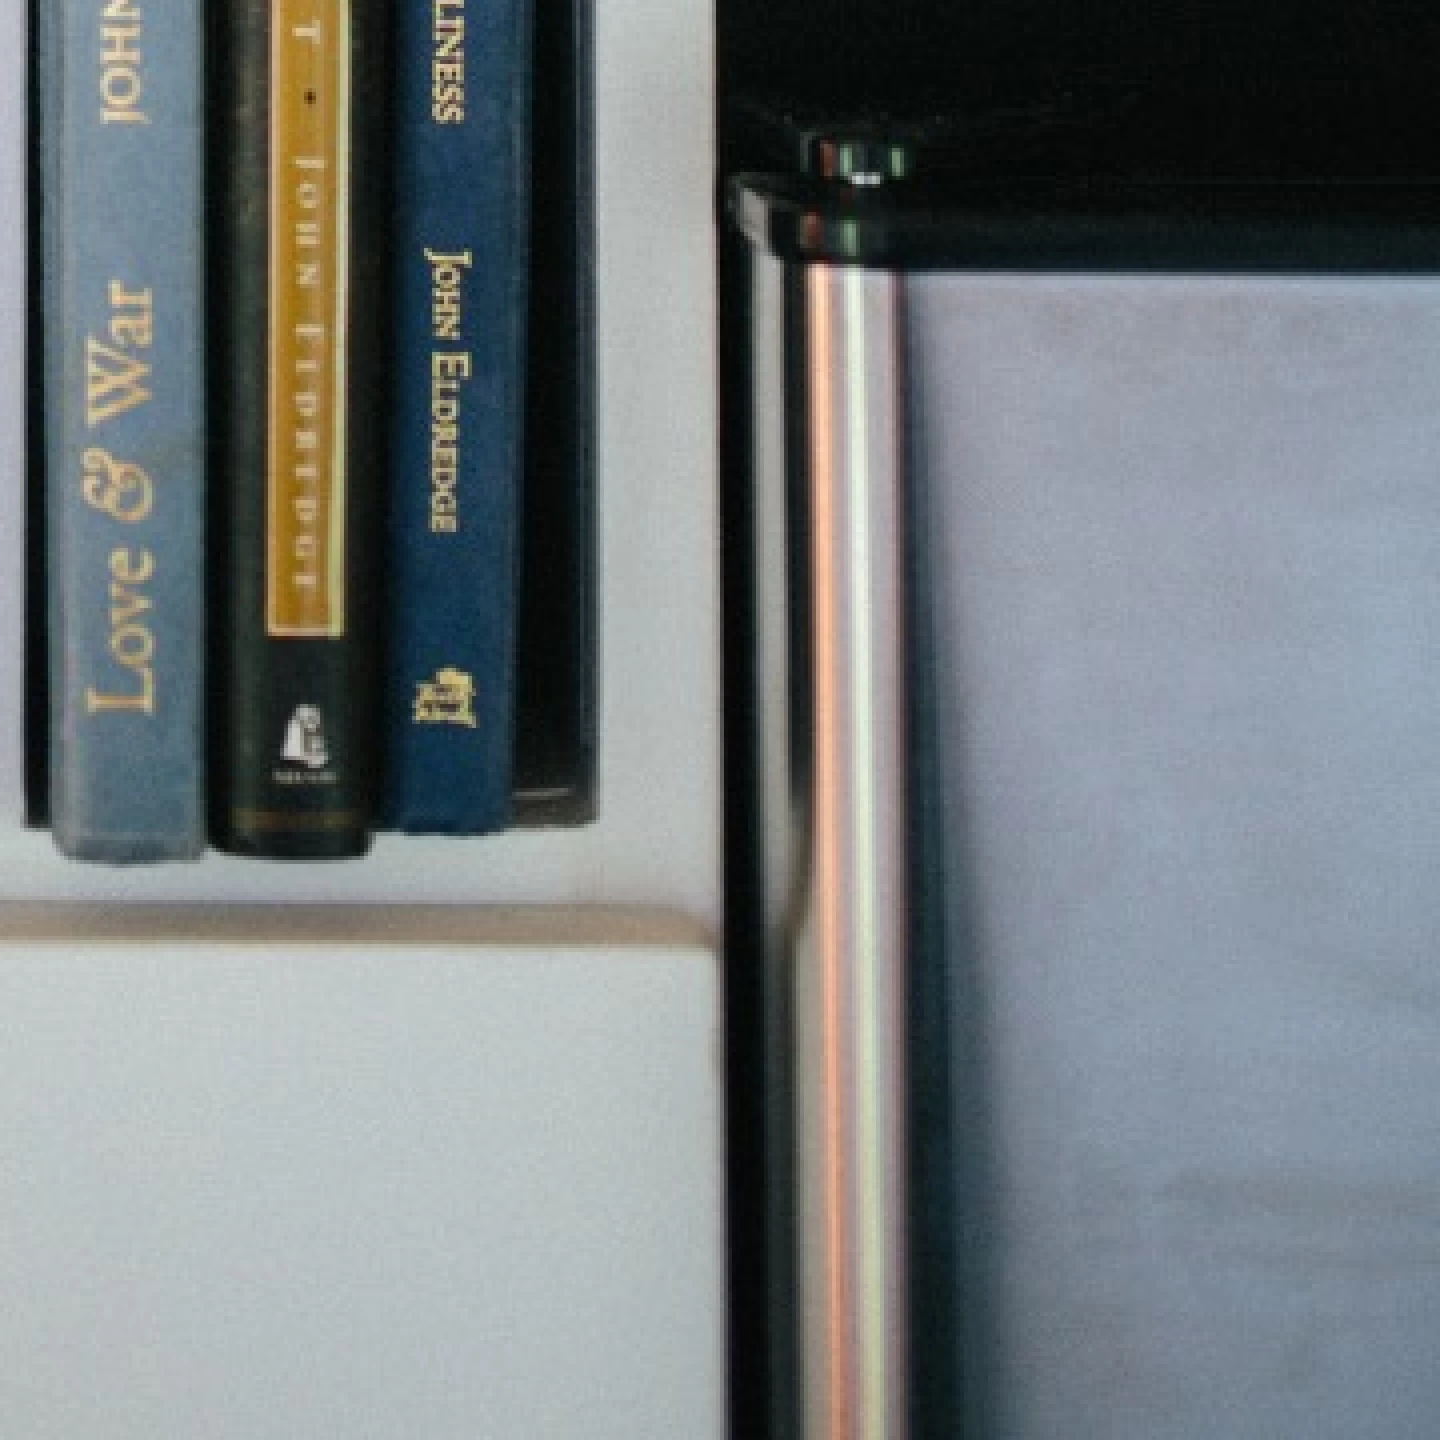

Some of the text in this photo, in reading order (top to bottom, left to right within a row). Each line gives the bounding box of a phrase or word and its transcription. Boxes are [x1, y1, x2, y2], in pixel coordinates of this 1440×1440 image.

[294, 156, 328, 289] JOHN
[80, 277, 155, 714] Love & War
[423, 247, 473, 534] JOHN ELDREDGE
